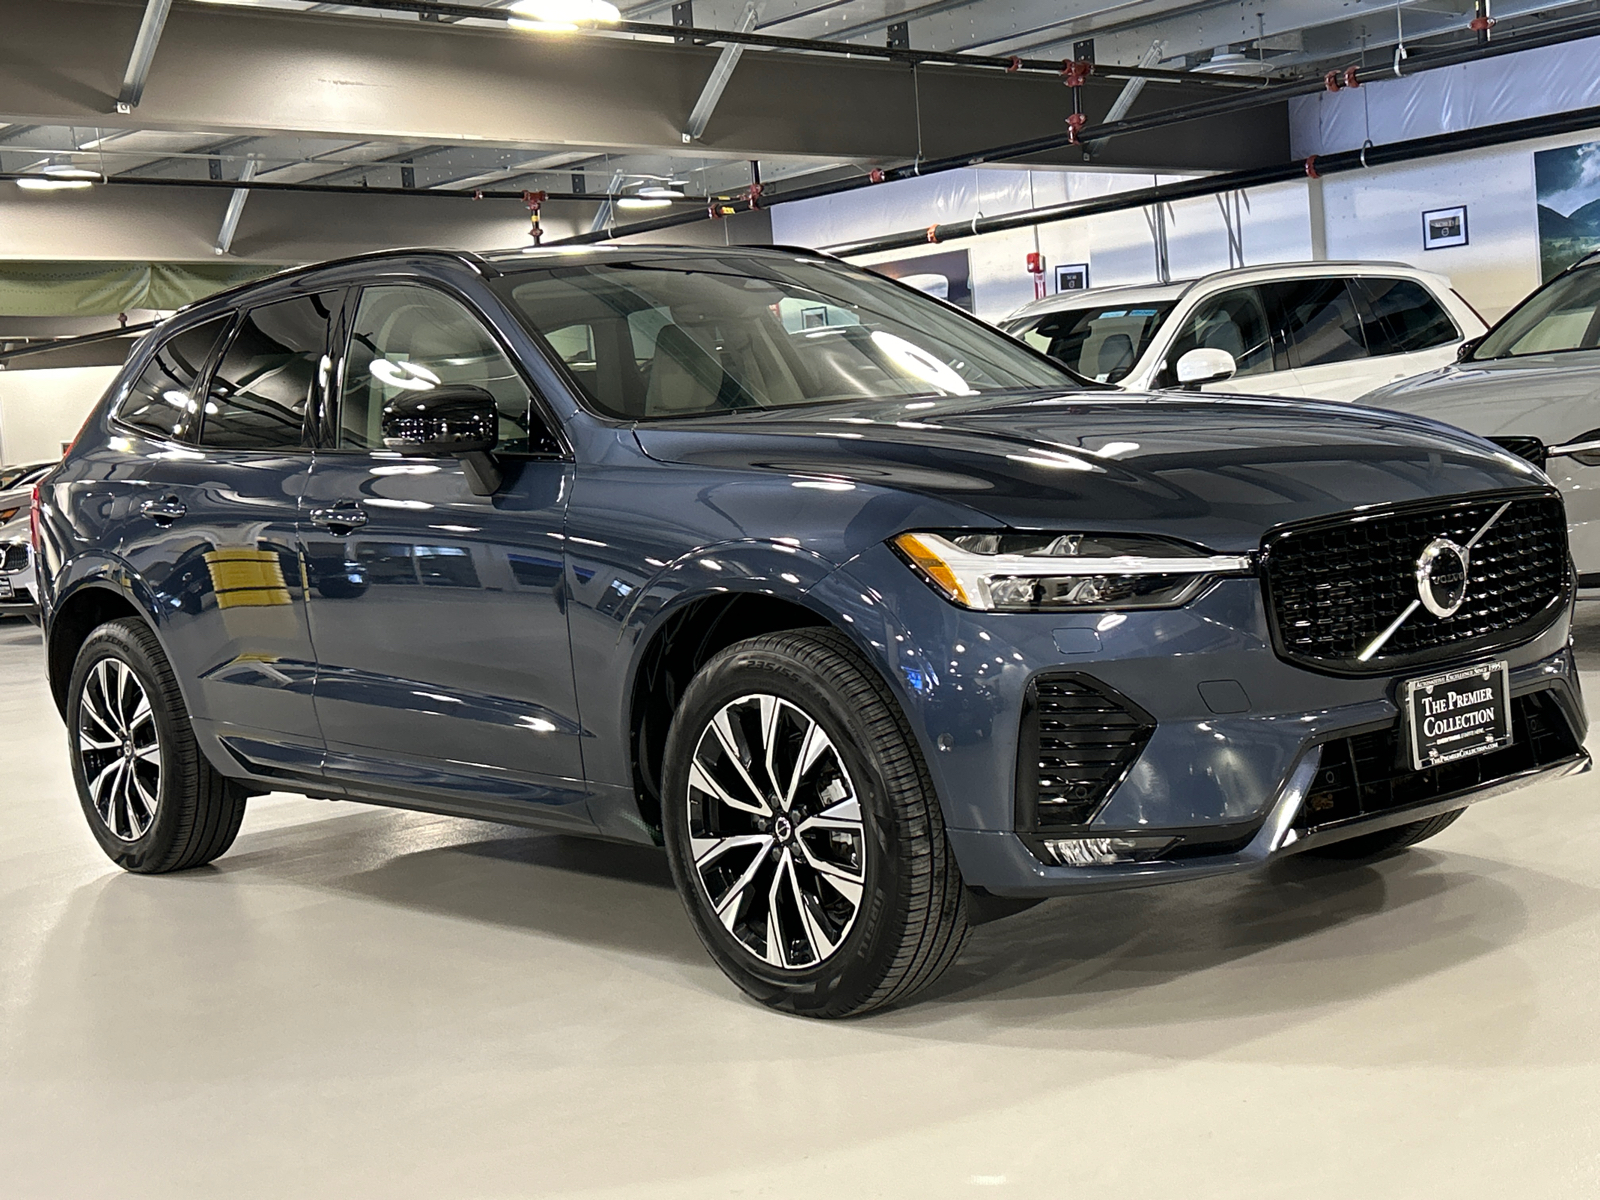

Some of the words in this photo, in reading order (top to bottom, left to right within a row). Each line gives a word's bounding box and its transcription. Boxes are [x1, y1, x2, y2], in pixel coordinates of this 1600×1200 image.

[745, 660, 802, 683] 235/55
[1421, 697, 1448, 716] THE
[1447, 687, 1494, 710] PREMIER
[1423, 707, 1495, 737] COLLECTION
